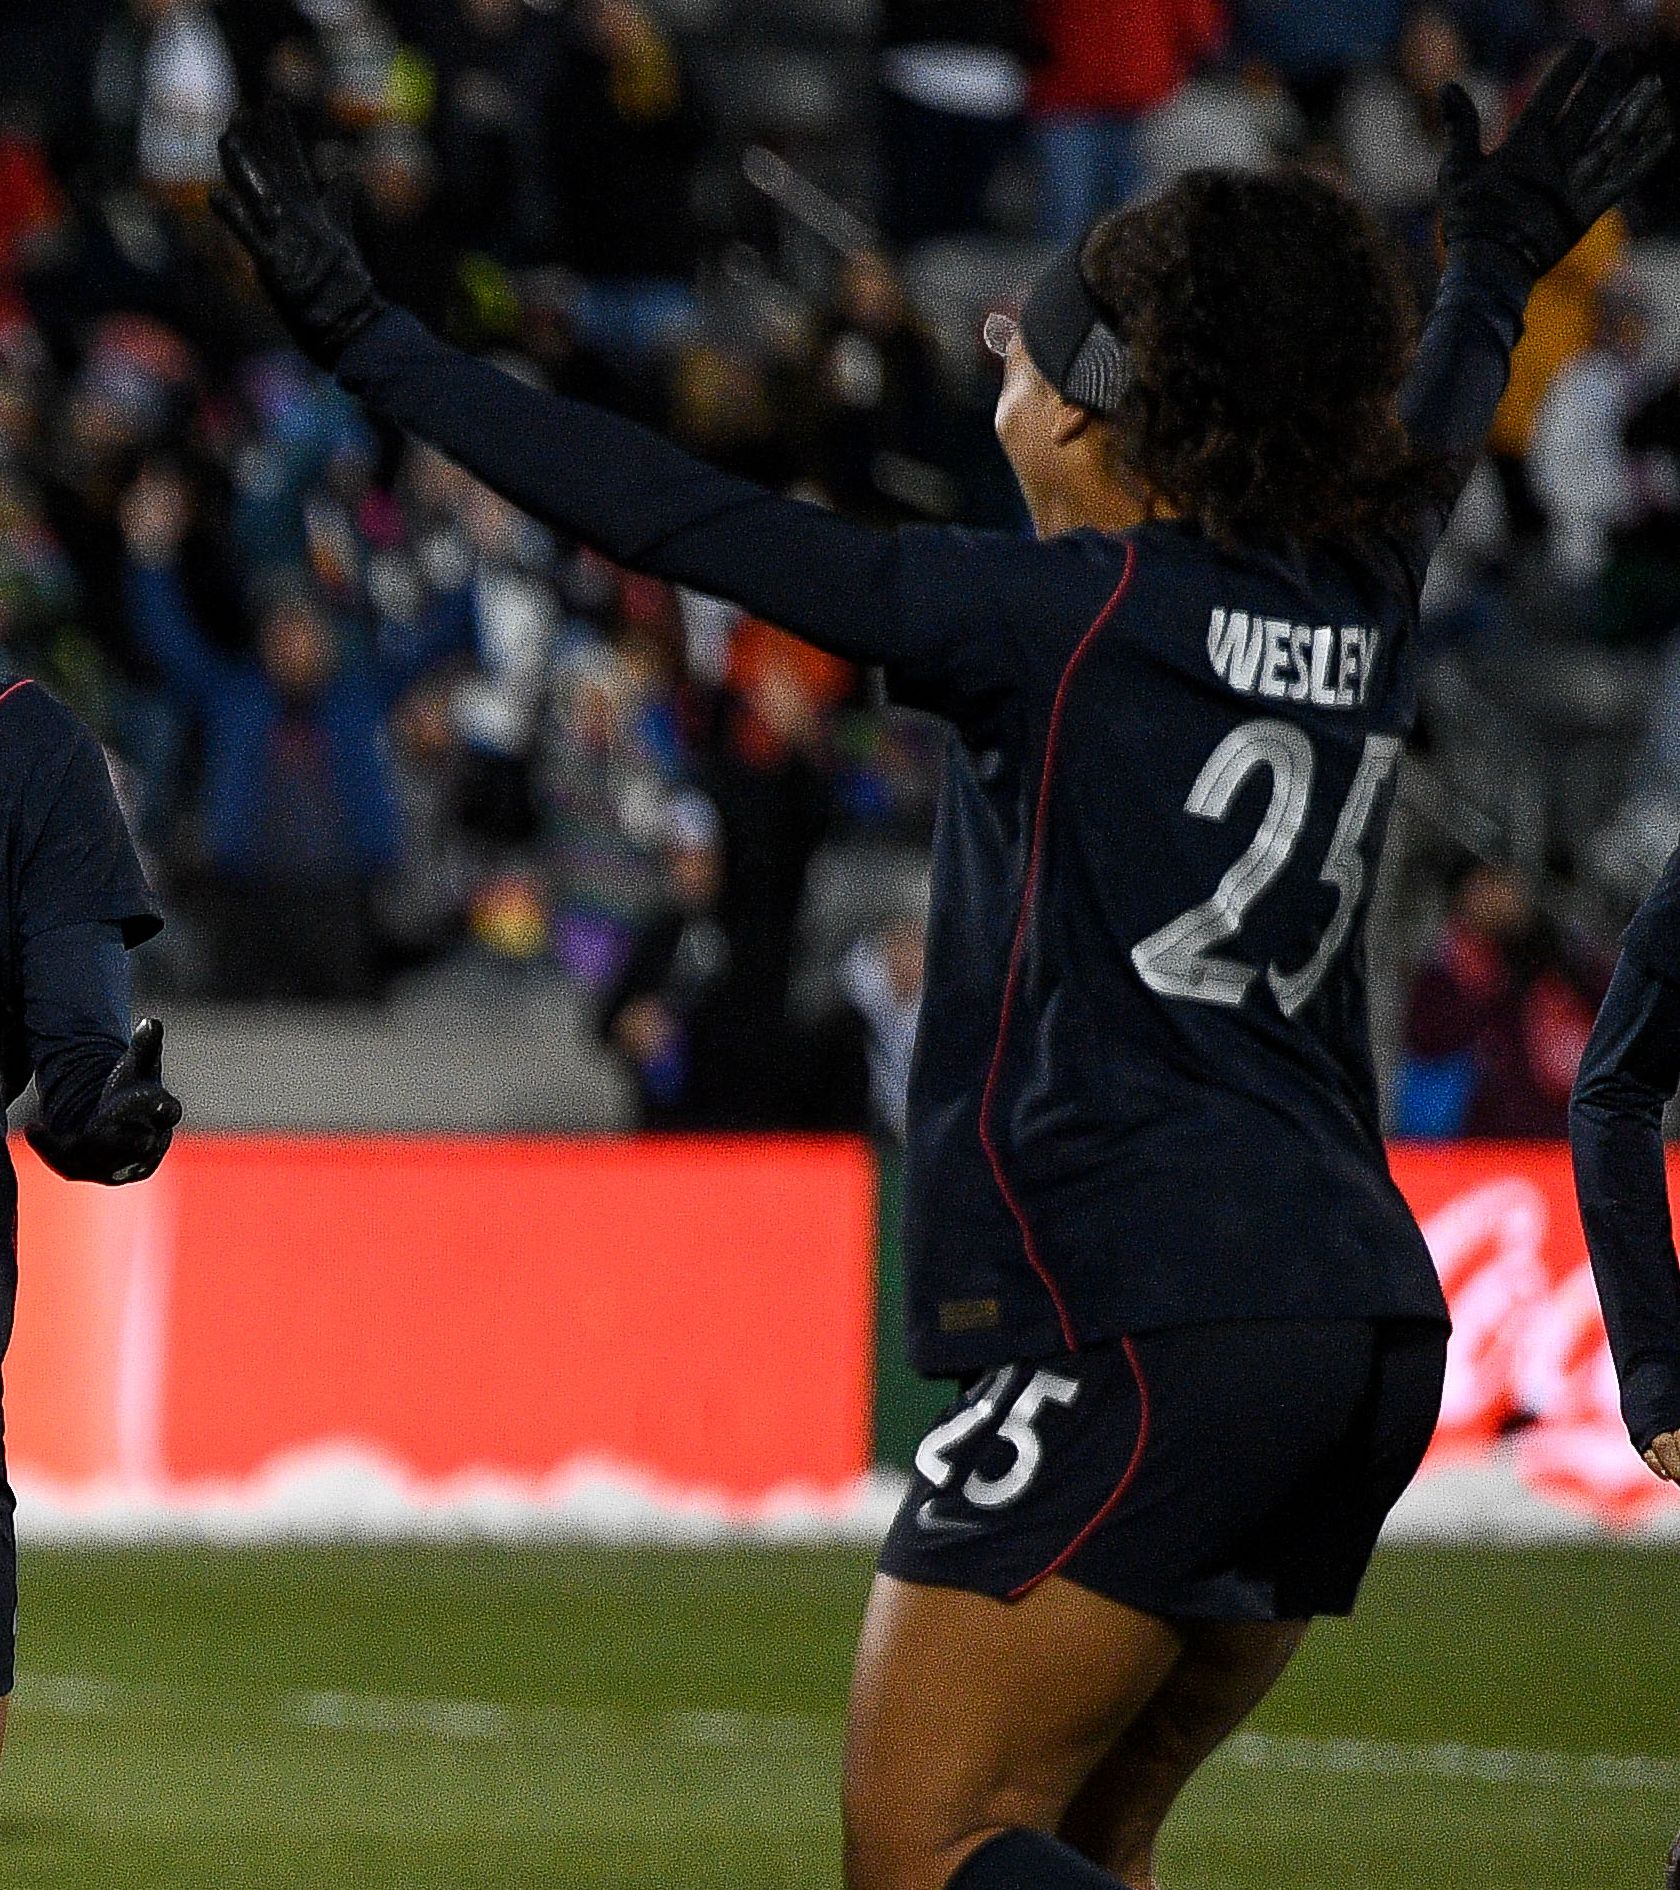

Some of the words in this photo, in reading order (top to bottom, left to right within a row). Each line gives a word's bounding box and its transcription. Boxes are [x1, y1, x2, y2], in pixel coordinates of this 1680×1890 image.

[1208, 608, 1380, 705] WESLEY
[1131, 718, 1402, 1018] 25
[915, 1364, 1080, 1506] 25
